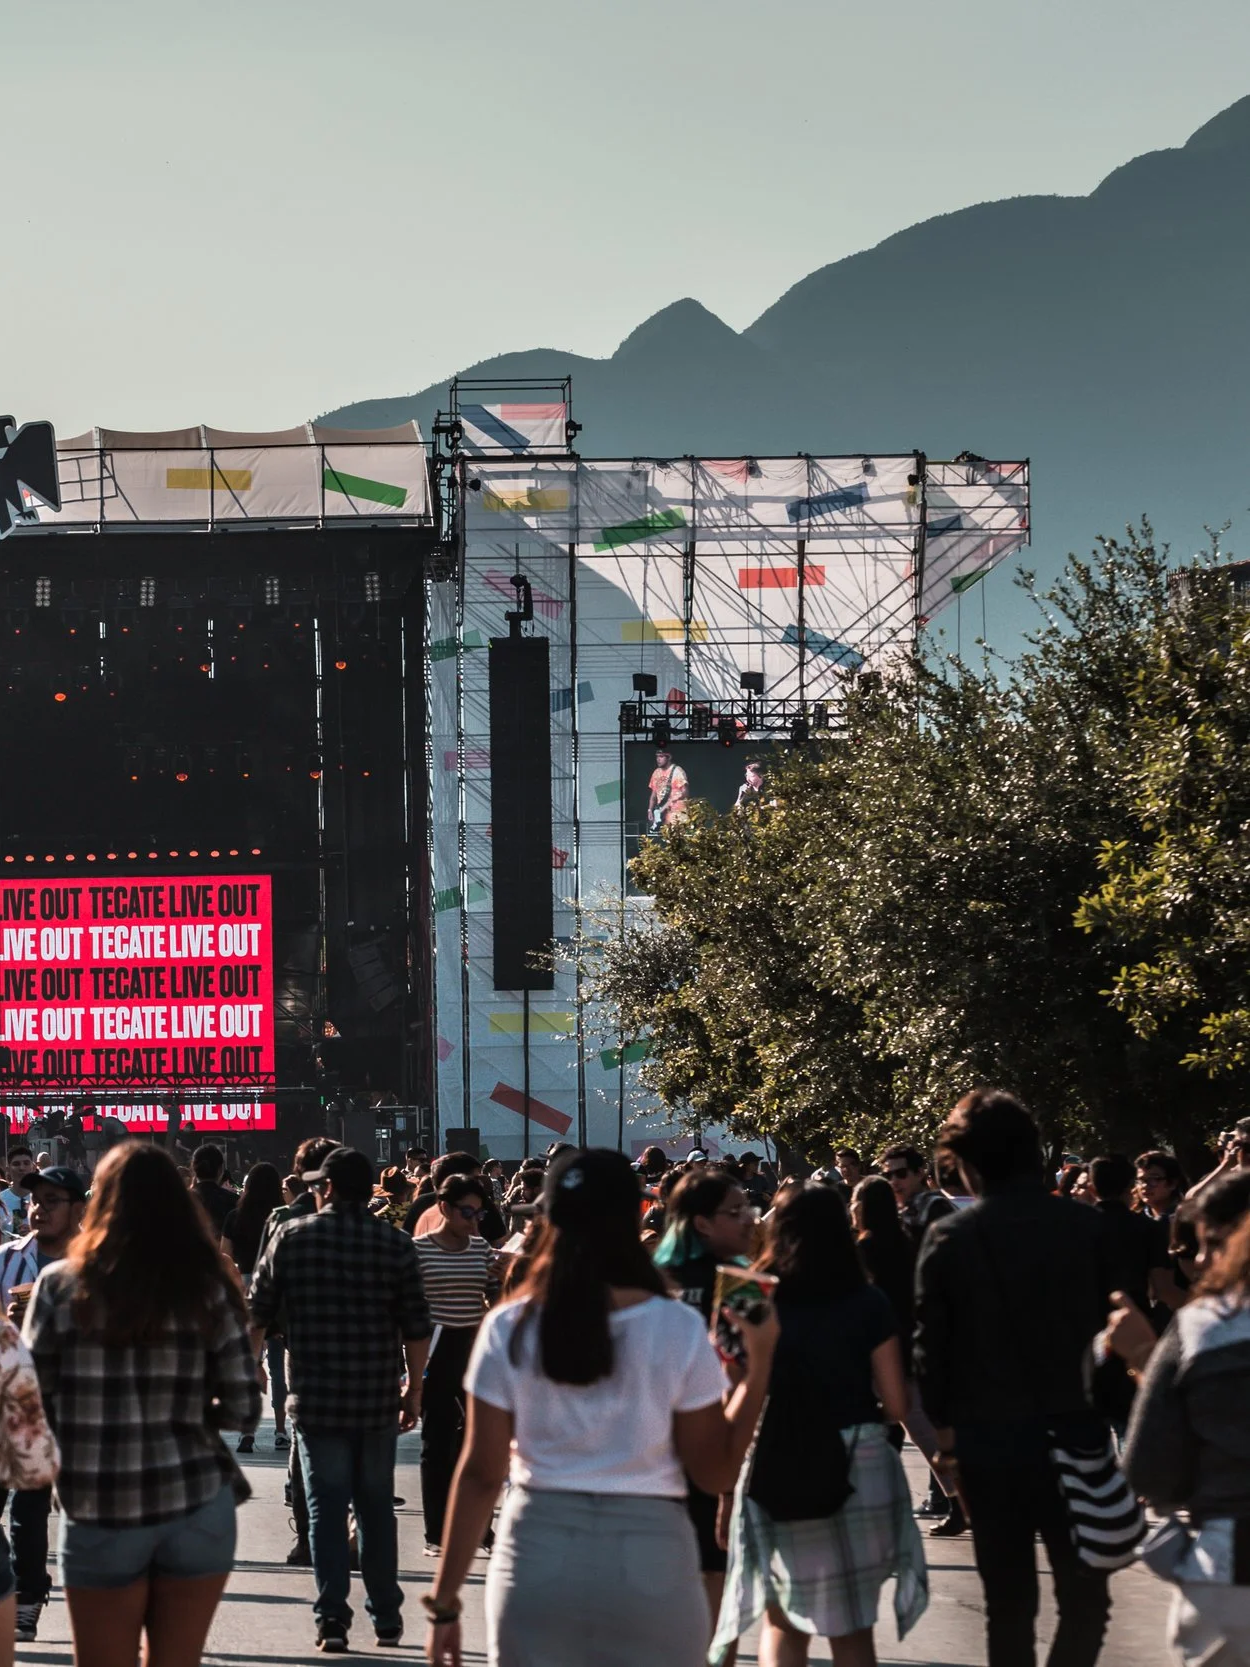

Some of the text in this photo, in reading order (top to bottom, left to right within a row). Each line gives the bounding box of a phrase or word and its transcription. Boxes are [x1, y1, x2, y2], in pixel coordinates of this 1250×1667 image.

[40, 887, 82, 920] OUT
[89, 886, 165, 919] TECATE
[169, 885, 214, 918] LIVE
[218, 884, 260, 917] OUT
[40, 927, 83, 961] OUT
[89, 925, 166, 960] TECATE
[169, 924, 215, 958] LIVE
[218, 924, 261, 957] OUT
[41, 968, 83, 1000] OUT
[90, 966, 166, 1000] TECATE
[170, 966, 215, 998] LIVE
[219, 965, 262, 998] OUT
[42, 1008, 85, 1041] OUT
[90, 1006, 167, 1040] TECATE
[171, 1005, 216, 1039] LIVE
[219, 1004, 263, 1038] OUT
